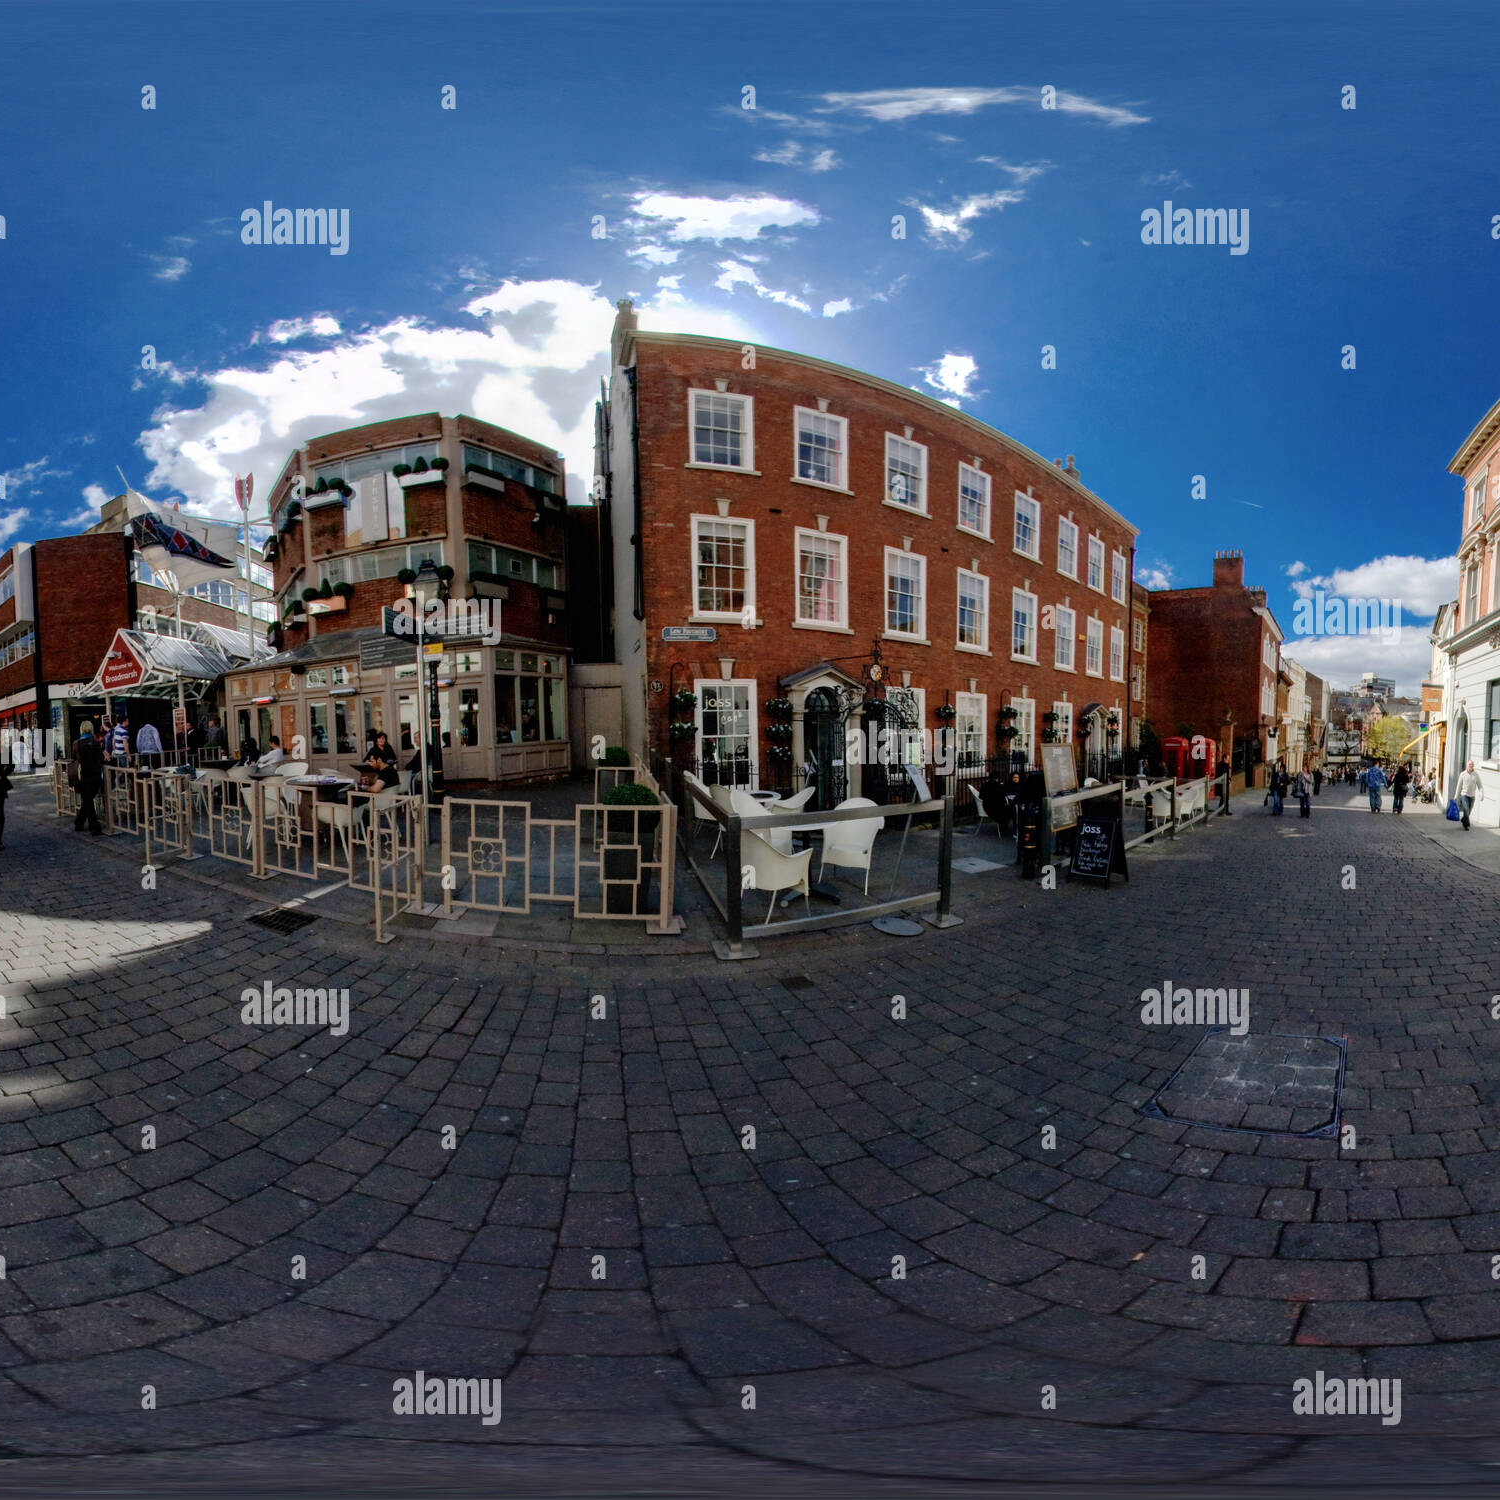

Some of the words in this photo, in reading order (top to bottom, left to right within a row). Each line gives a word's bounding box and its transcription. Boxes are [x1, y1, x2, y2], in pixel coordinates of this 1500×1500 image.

[105, 669, 138, 684] Broadmarsh
[703, 695, 732, 711] joss
[1080, 823, 1101, 835] joss
